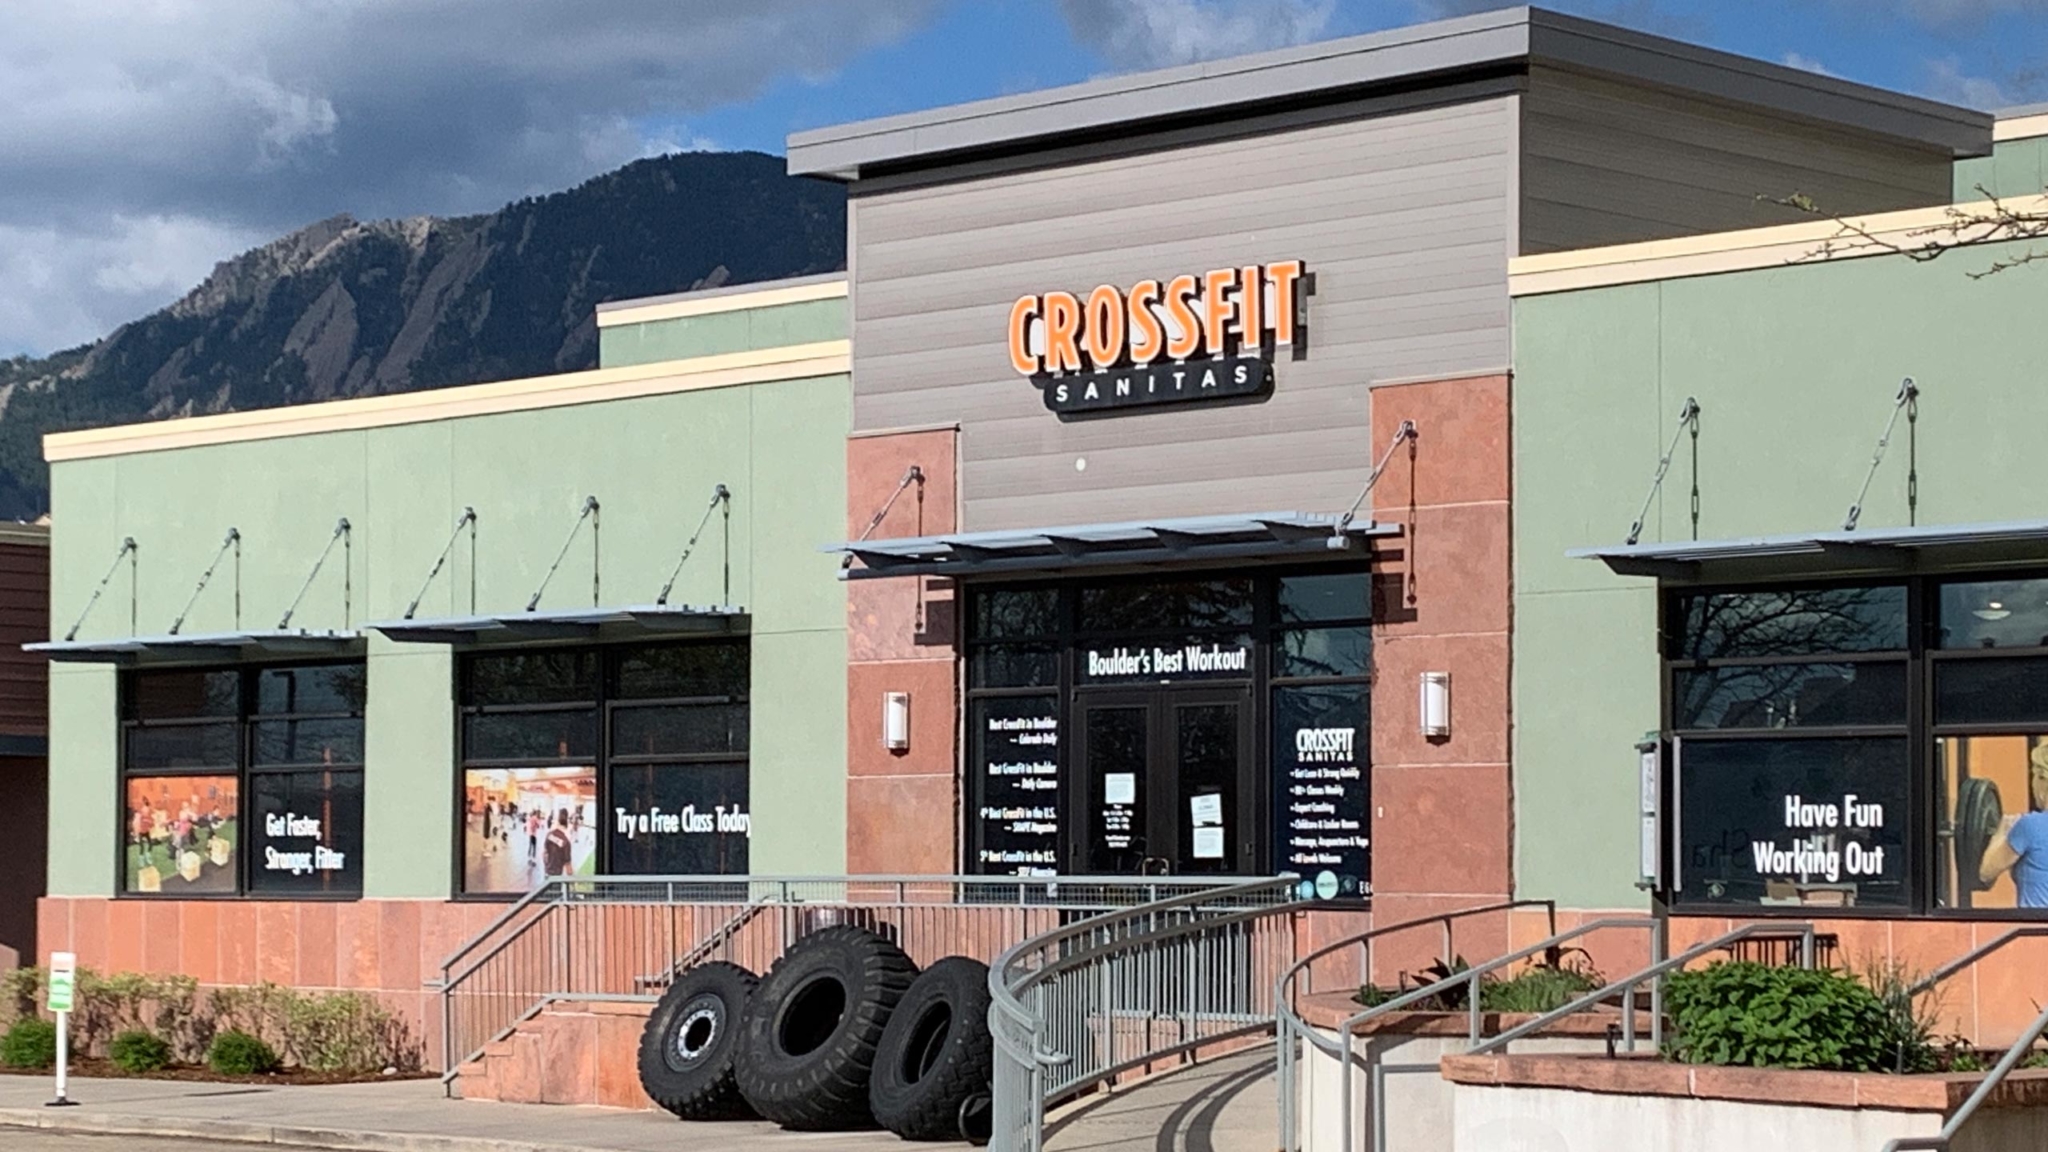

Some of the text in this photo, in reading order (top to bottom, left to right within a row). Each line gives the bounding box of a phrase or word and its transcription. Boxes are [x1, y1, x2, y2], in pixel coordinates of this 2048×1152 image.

[1008, 260, 1300, 375] CROSSFIT
[1056, 366, 1248, 402] SANITAS
[1088, 643, 1246, 676] Boulder's Best Workout
[1296, 728, 1355, 752] CROSSFIT
[1298, 752, 1353, 762] SANITAS
[266, 812, 322, 841] Get Faster,
[616, 808, 637, 839] Try
[639, 814, 647, 833] a
[651, 808, 678, 833] Free
[682, 804, 713, 833] Class
[1785, 795, 1883, 828] Have Fun
[265, 846, 345, 875] Stronger, Fitter
[1753, 840, 1884, 882] Working Out
